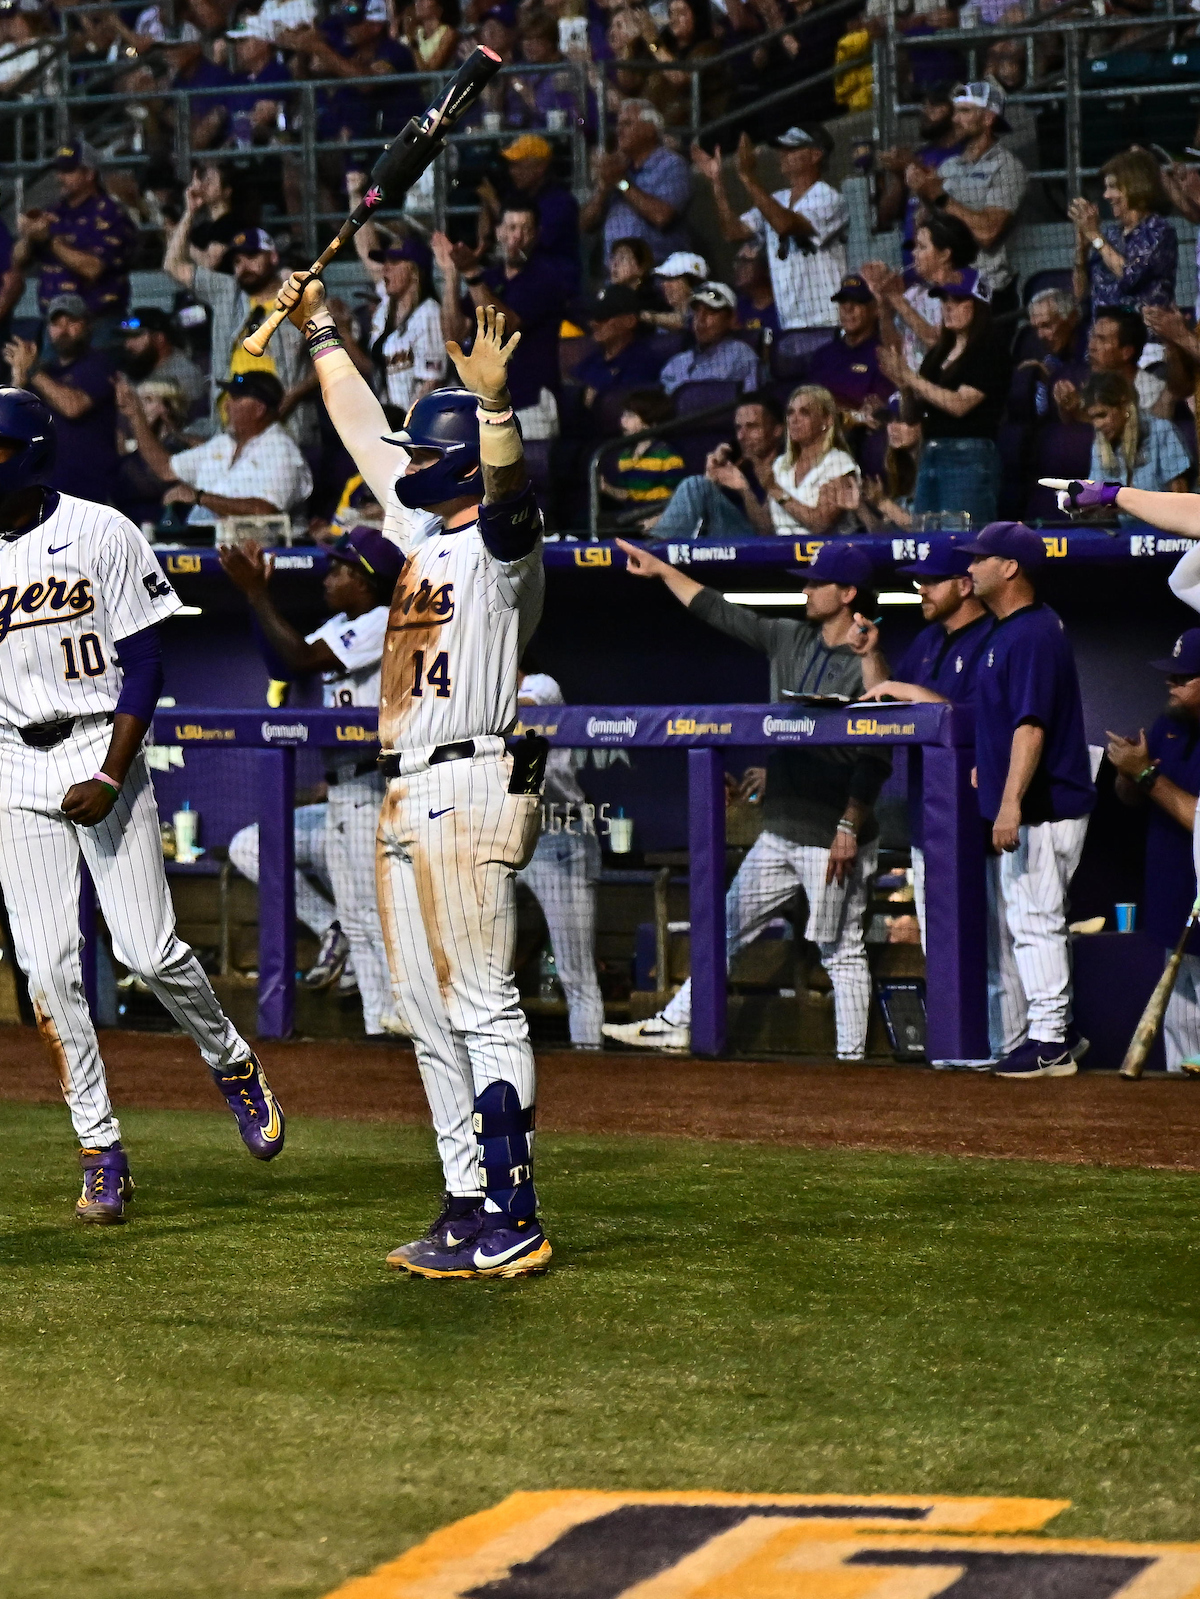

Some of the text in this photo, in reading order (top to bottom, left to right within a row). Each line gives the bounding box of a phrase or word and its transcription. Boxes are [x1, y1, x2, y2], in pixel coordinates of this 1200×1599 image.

[574, 547, 612, 567] LSU
[794, 540, 825, 563] LS
[167, 554, 202, 574] LSU
[60, 632, 108, 681] 10
[411, 648, 452, 698] 14
[261, 720, 309, 743] Community
[586, 716, 638, 739] Community
[763, 715, 816, 738] Community
